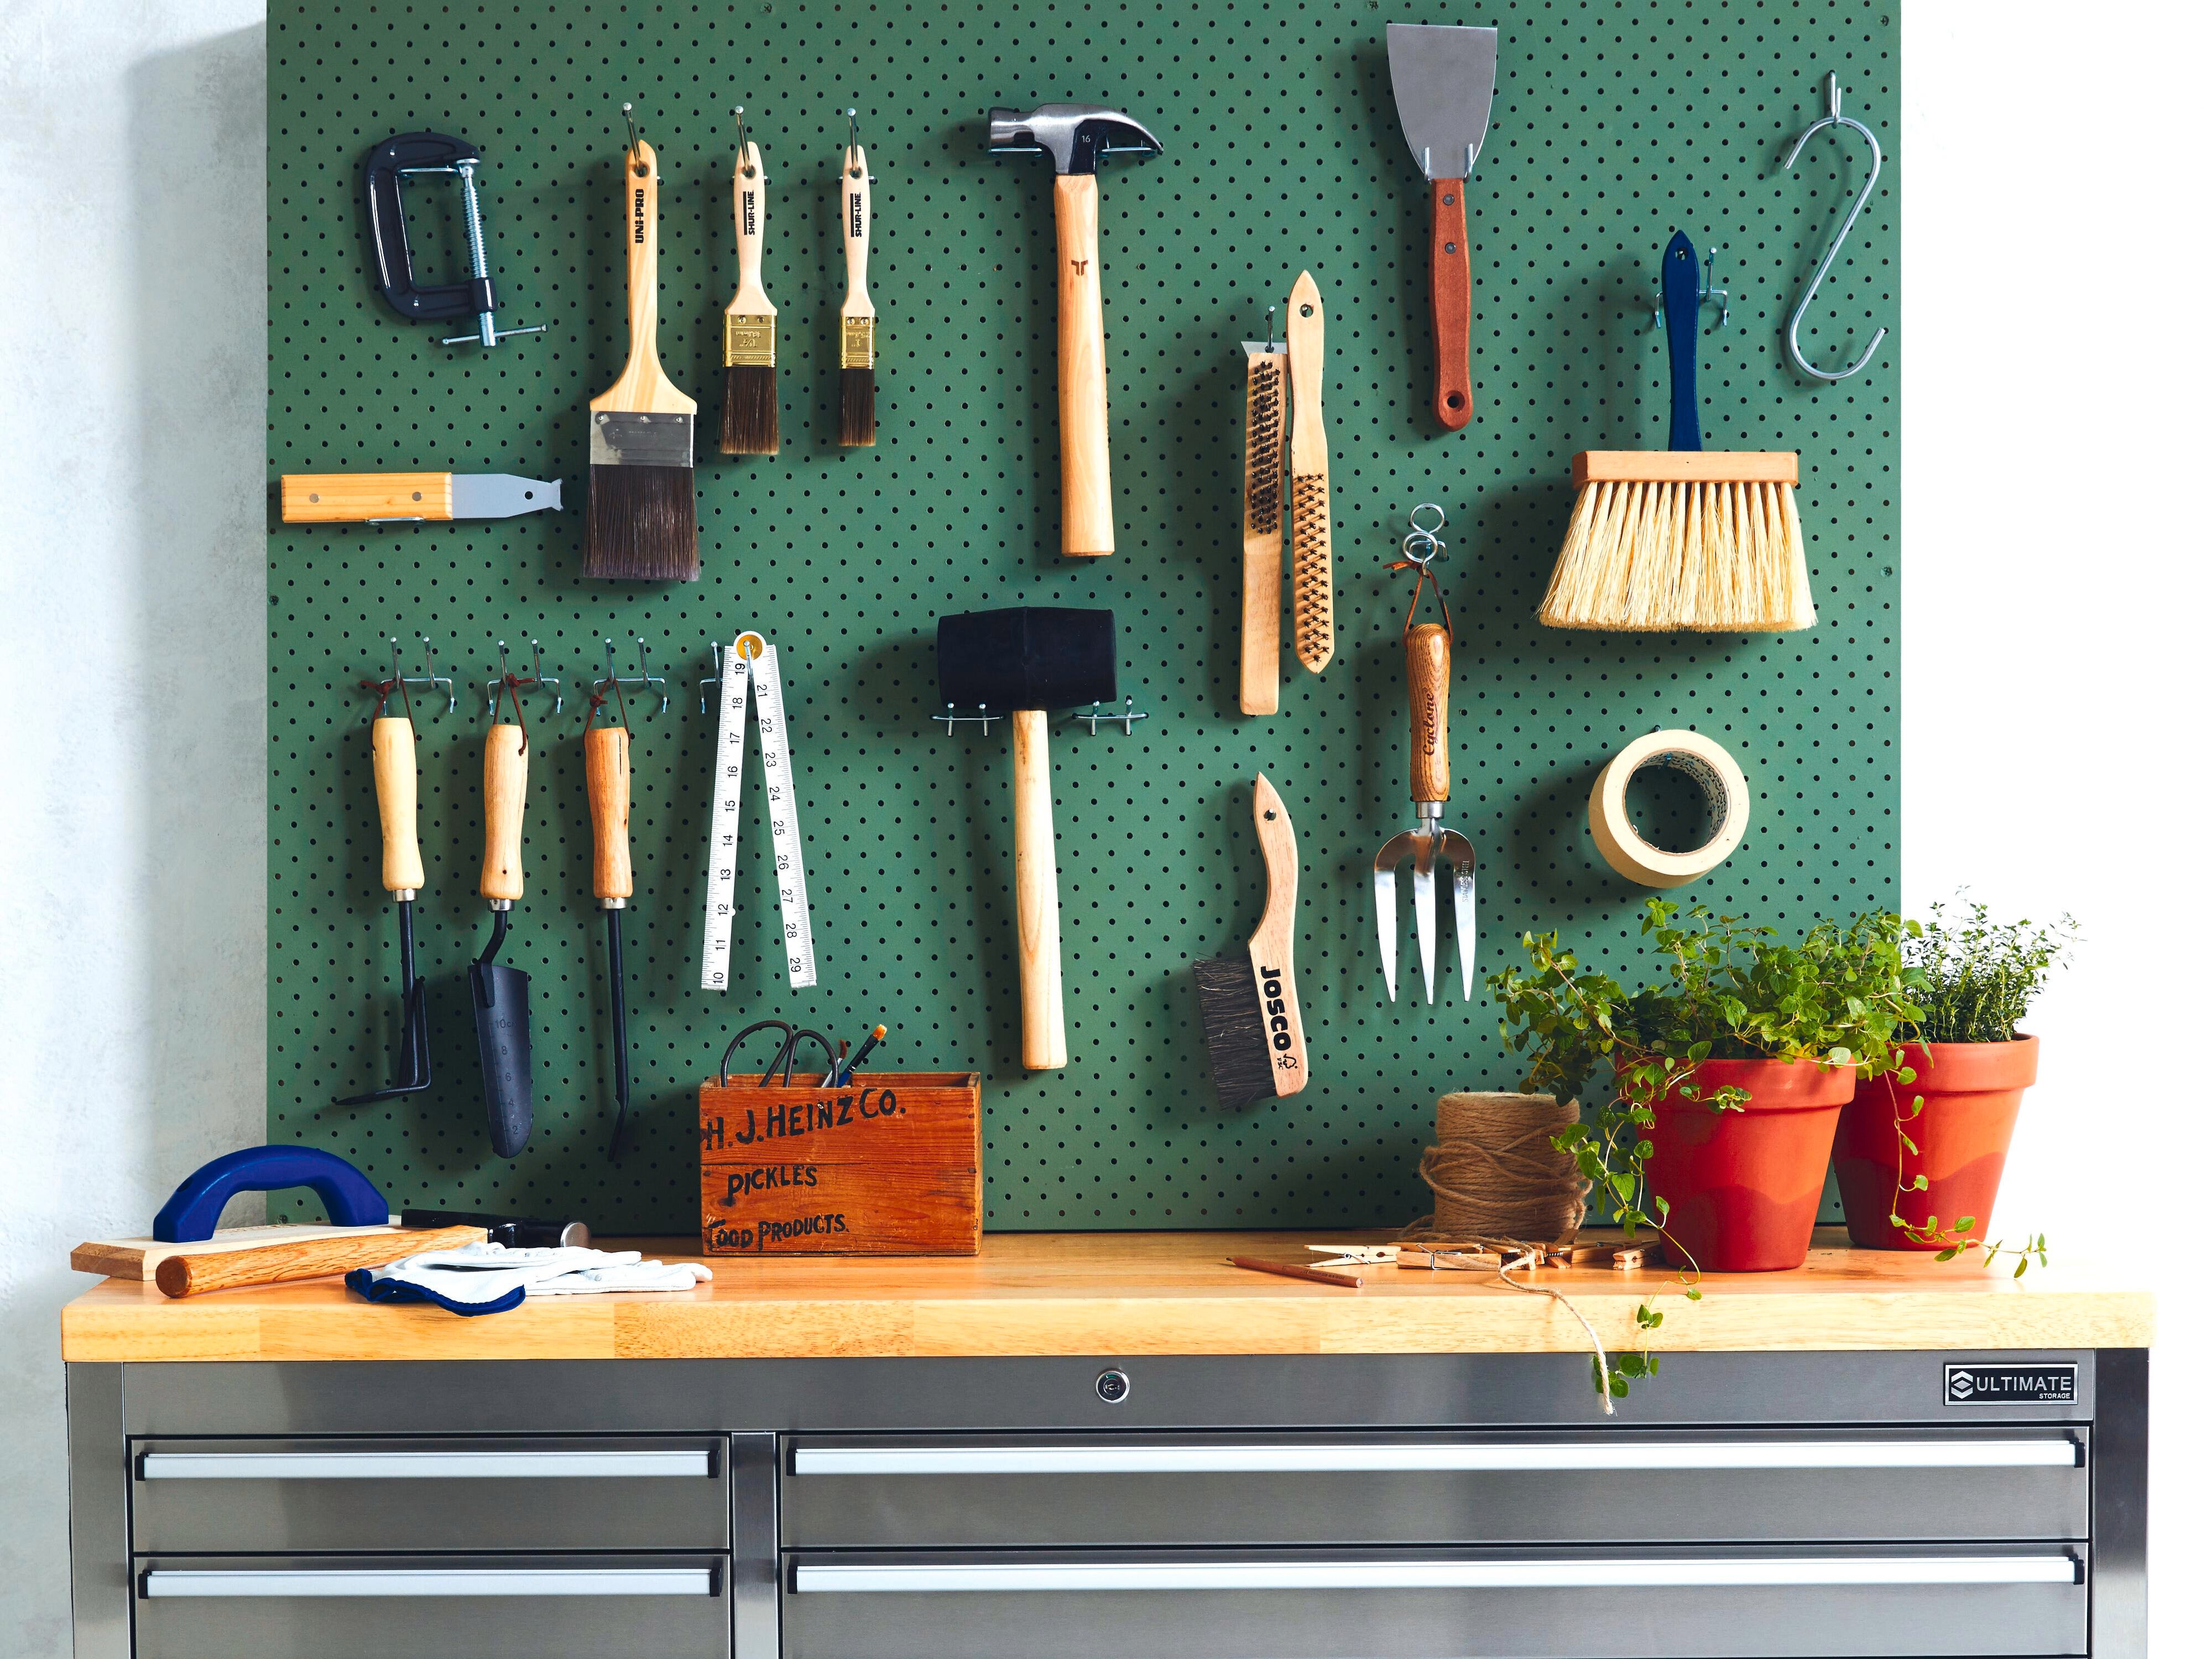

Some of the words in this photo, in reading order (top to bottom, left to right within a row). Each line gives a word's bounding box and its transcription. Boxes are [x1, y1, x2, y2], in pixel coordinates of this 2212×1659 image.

[734, 663, 745, 675] 19
[757, 684, 768, 697] 21
[732, 697, 743, 709] 18
[761, 718, 773, 733] 22
[1422, 692, 1438, 756] Cyclone
[730, 732, 740, 744] 17
[765, 752, 776, 768] 23
[727, 766, 738, 778] 16
[769, 786, 780, 801] 24
[725, 800, 735, 812] 15
[773, 821, 785, 836] 25
[723, 834, 733, 847] 14
[778, 855, 789, 870] 26
[720, 869, 731, 881] 13
[781, 889, 793, 904] 27
[718, 904, 728, 916] 12
[786, 923, 797, 938] 28
[716, 938, 726, 951] 11
[790, 957, 801, 972] 29
[713, 972, 724, 984] 10
[1260, 966, 1291, 1051] JOSCO
[859, 1088, 906, 1119] CO.
[727, 1166, 818, 1206] PICKLES
[1976, 1376, 2072, 1391] ULTIMATE
